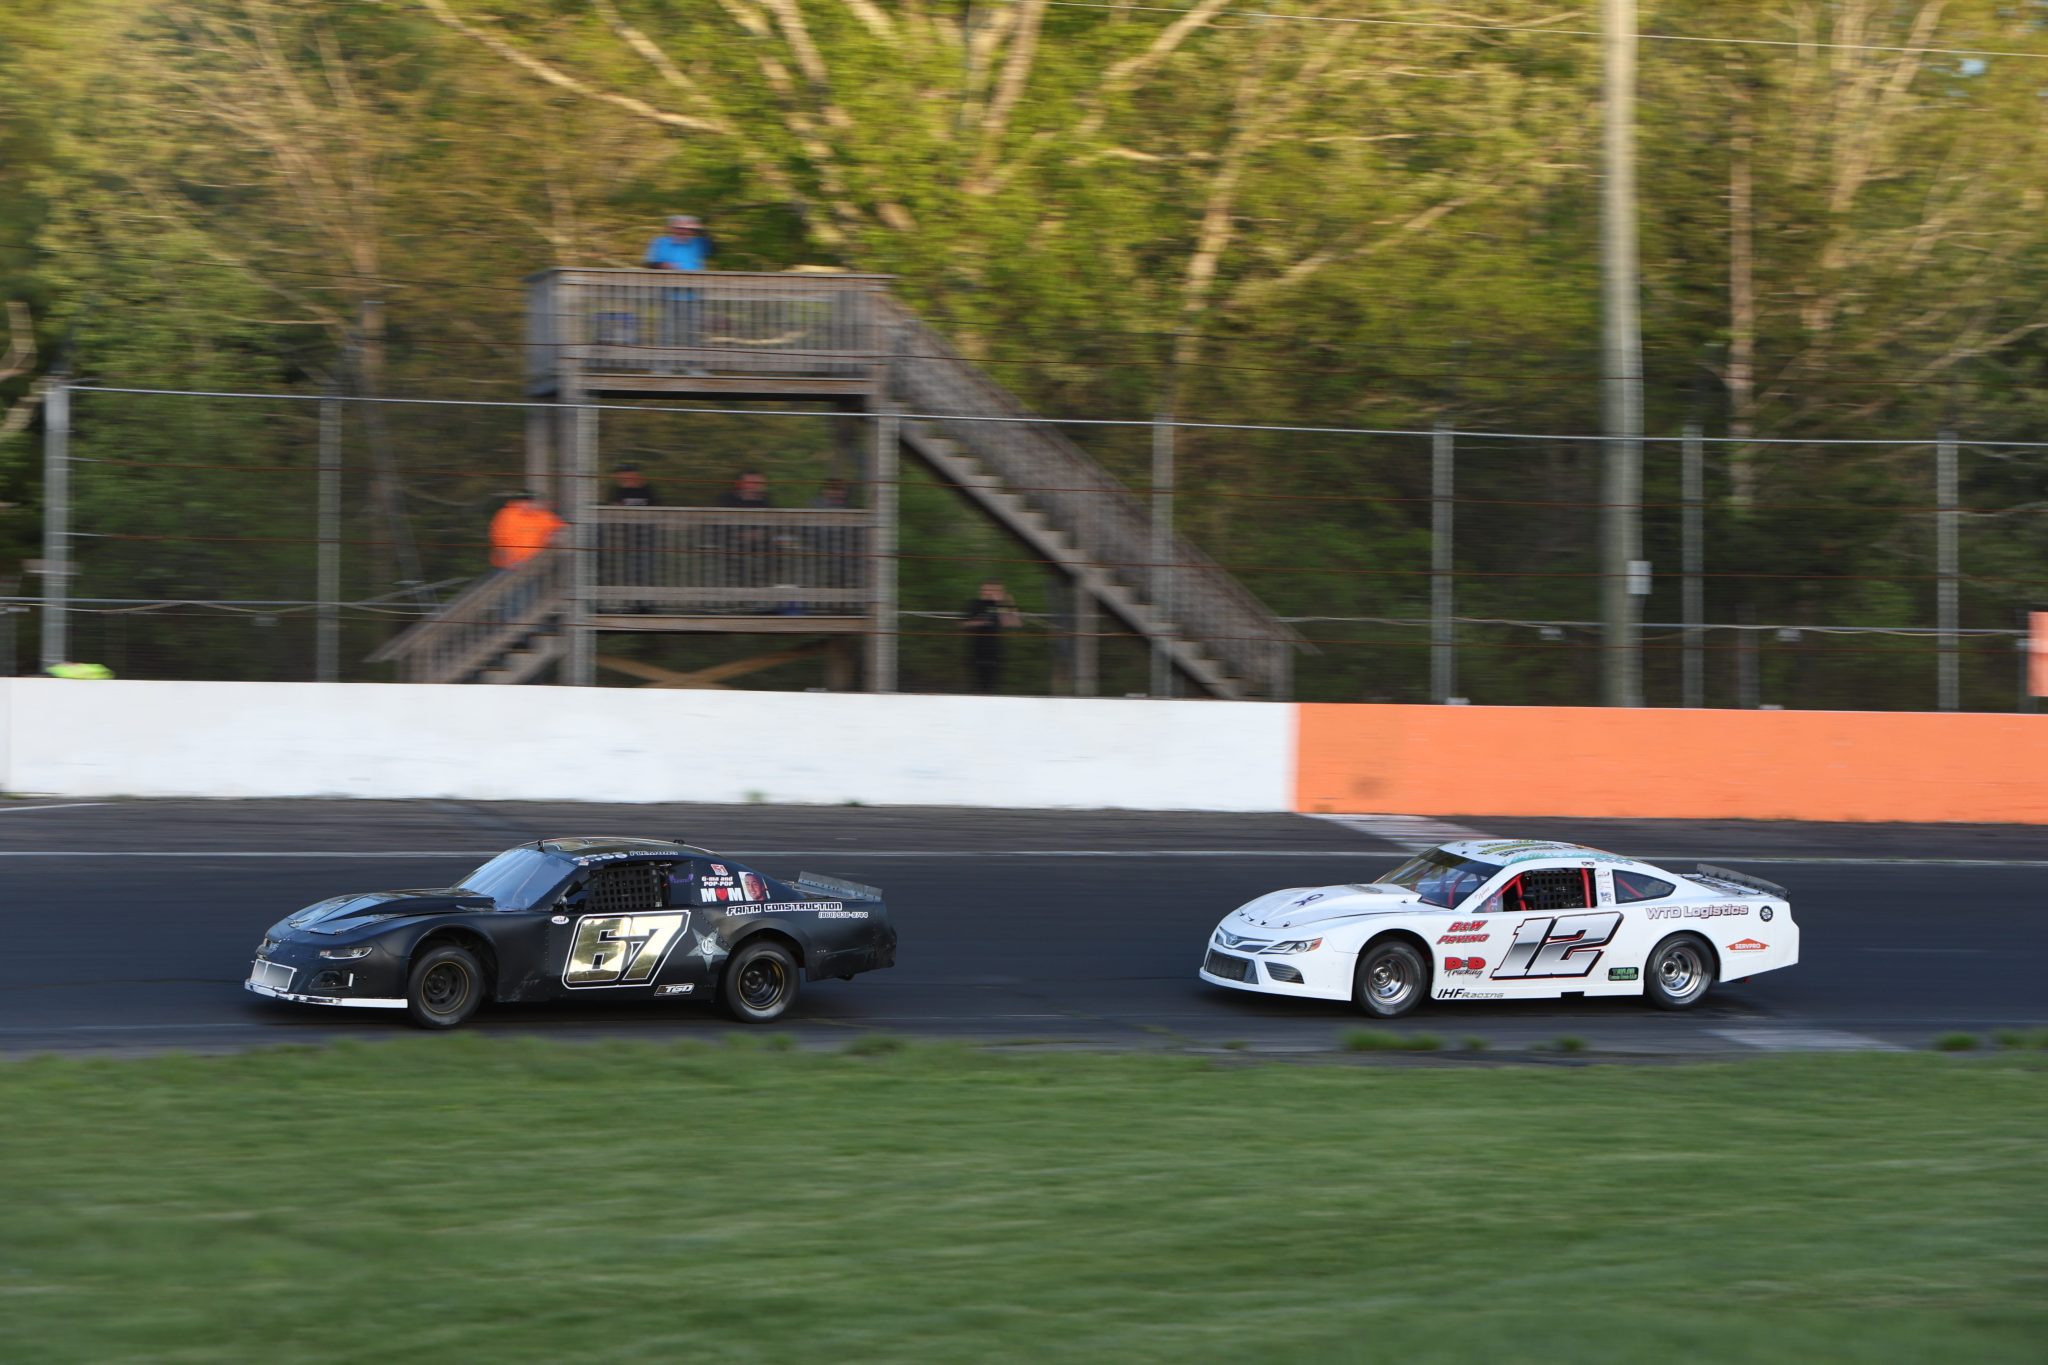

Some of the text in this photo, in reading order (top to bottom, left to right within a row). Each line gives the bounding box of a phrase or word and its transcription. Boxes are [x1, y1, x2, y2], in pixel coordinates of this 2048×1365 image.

[727, 902, 842, 916] FAITH CONSTRUCTION
[1646, 904, 1749, 919] WTD Logistics
[1447, 920, 1488, 932] B&W
[562, 910, 691, 989] 67
[1489, 911, 1624, 980] 12
[1437, 988, 1465, 998] IHF
